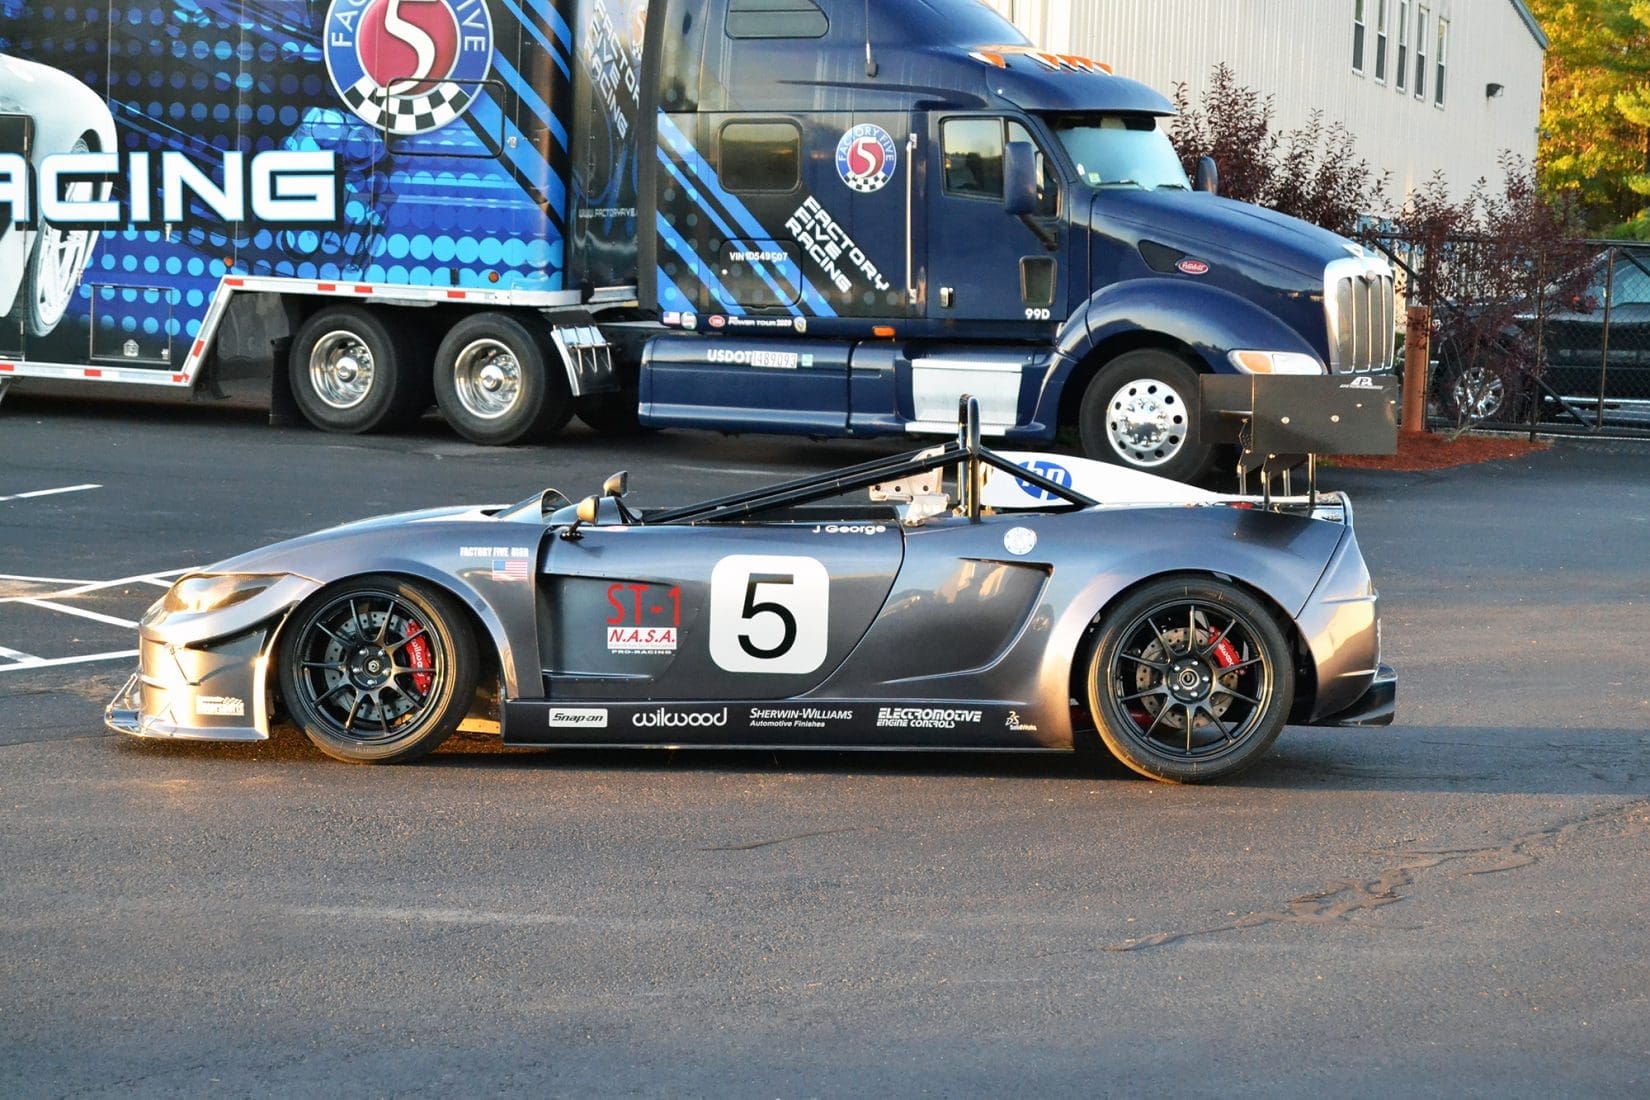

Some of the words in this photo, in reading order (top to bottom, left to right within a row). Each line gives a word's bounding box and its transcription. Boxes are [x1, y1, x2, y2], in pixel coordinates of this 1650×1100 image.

[593, 0, 640, 110] FACTOR
[584, 35, 628, 140] RACING
[839, 126, 880, 161] FACTORY
[879, 134, 895, 162] FIVE
[0, 150, 336, 223] ACING
[794, 206, 842, 260] FIVE
[803, 195, 890, 291] FACTORY
[785, 216, 852, 293] RACING
[1024, 308, 1051, 320] 99D
[812, 525, 821, 533] J
[825, 525, 886, 535] George
[606, 583, 681, 626] ST-1
[737, 572, 797, 659] 5
[609, 629, 676, 643] N.A.S.A.
[410, 639, 425, 677] wilwod
[552, 713, 604, 724] Snap-on
[632, 707, 728, 727] wilwood
[749, 707, 853, 720] SHERWIN-WILLIAMS
[878, 707, 983, 722] ELECTROMOTIVE
